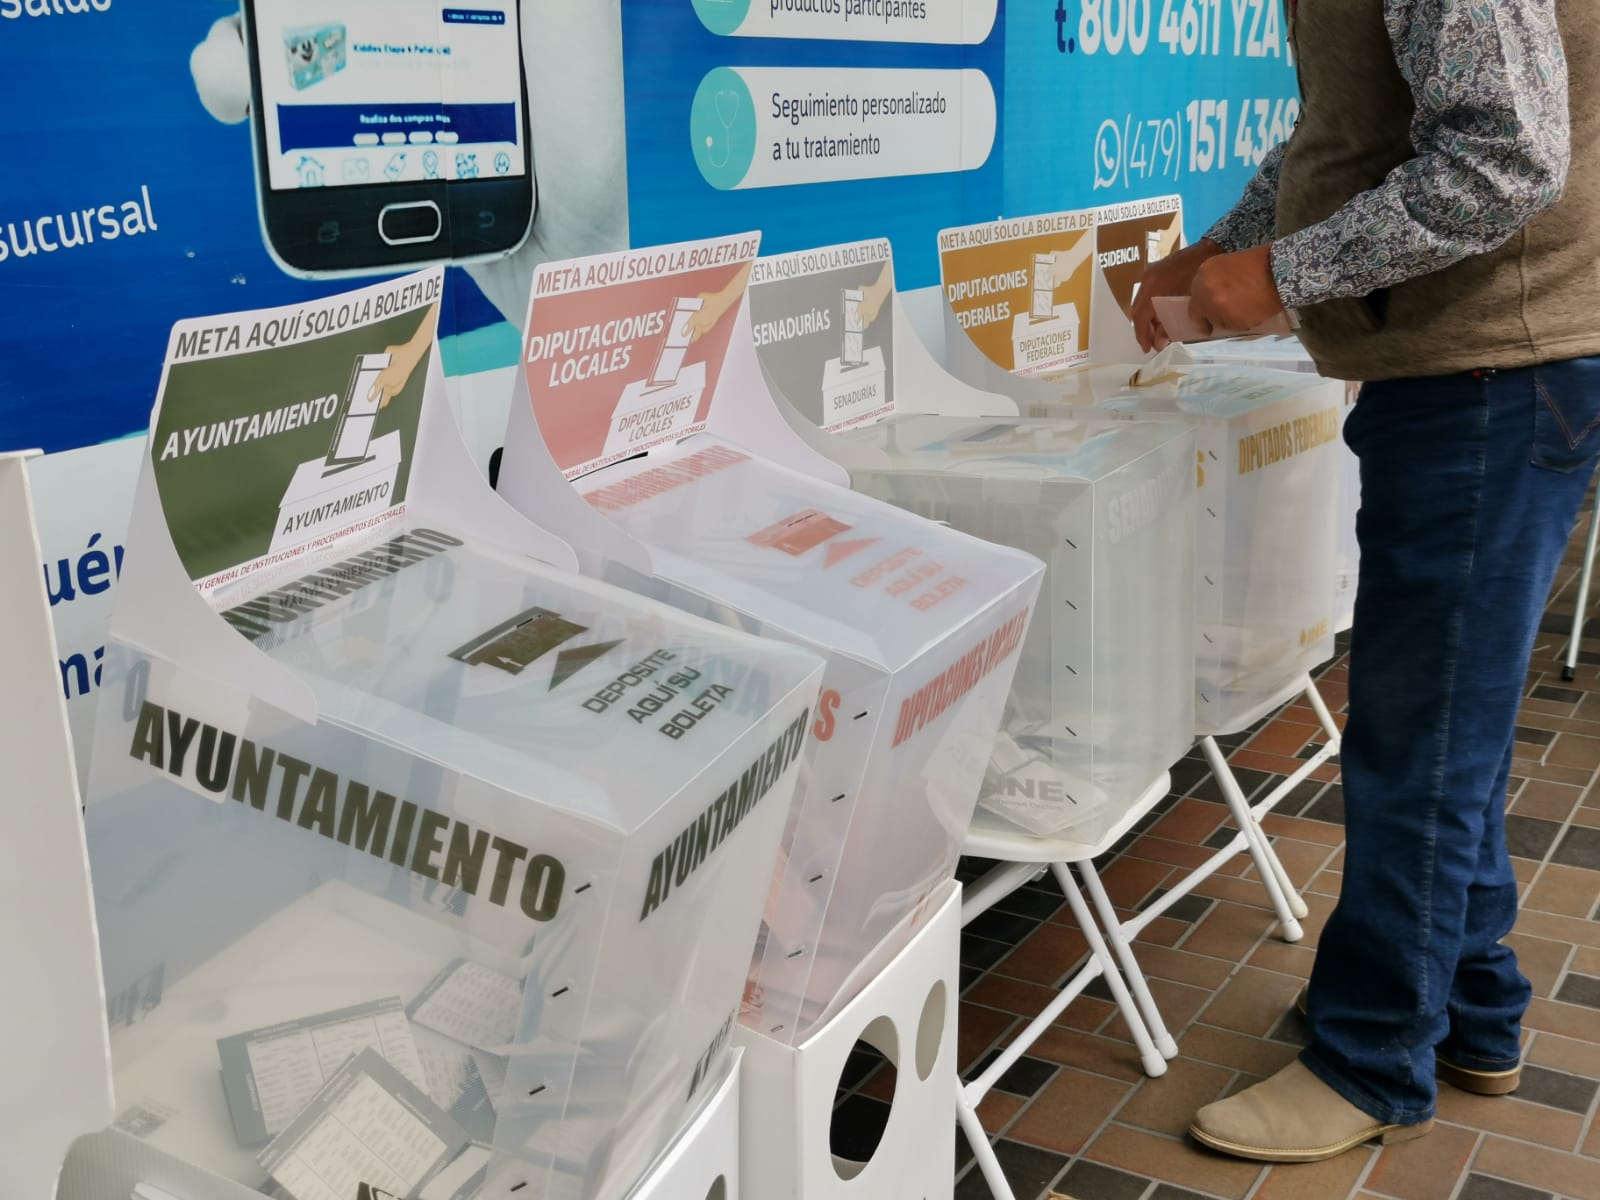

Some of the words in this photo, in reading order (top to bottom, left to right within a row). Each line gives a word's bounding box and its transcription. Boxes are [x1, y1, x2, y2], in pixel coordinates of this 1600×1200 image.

[845, 0, 926, 24] participantes
[1158, 0, 1221, 56] 4611
[772, 92, 858, 125] Seguimiento
[862, 91, 946, 122] personalizado
[772, 142, 782, 160] a
[786, 136, 800, 159] tu
[804, 132, 880, 158] tratamiento
[1123, 111, 1182, 189] (479)
[1186, 99, 1228, 173] 151
[940, 229, 968, 250] META
[968, 223, 993, 246] AQUÍ
[994, 222, 1020, 241] SOLO
[1022, 220, 1035, 236] LA
[1037, 214, 1076, 234] BOLETA
[1079, 212, 1094, 228] DE
[536, 268, 581, 295] META
[585, 255, 626, 287] AQUÍ
[628, 253, 666, 280] SOLO
[668, 251, 686, 272] LA
[688, 243, 738, 269] BOLETA
[740, 239, 758, 259] DE
[775, 254, 800, 278] AQUÍ
[802, 252, 828, 273] SOLO
[829, 250, 841, 268] LA
[843, 247, 877, 266] BOLETA
[878, 242, 890, 259] DE
[1098, 245, 1140, 268] ESIDENCIA
[948, 268, 1028, 302] DIPUTACIONES
[174, 324, 241, 359] META
[246, 309, 303, 348] AQUÍ
[303, 304, 350, 338] SOLO
[352, 298, 370, 326] LA
[374, 282, 423, 320] BOLETA
[425, 275, 441, 302] DE
[527, 309, 667, 363] DIPUTACIONES
[752, 307, 831, 347] SENADURÍAS
[1019, 329, 1072, 353] DIPUTACIONES
[548, 345, 633, 388] LOCALES
[1026, 343, 1065, 363] FEDERALES
[618, 394, 693, 432] DIPUTACIONES
[833, 383, 877, 410] SENADURÍAS
[160, 393, 339, 461] AYUNTAMIENTO
[628, 416, 675, 443] LOCALES
[1238, 421, 1293, 475] DIPUTADOS
[282, 481, 390, 535] AYUNTAMIENTO
[204, 568, 239, 589] GENERAL
[240, 564, 252, 576] DE
[251, 544, 305, 571] INSTITUCIONES
[311, 521, 368, 550] PROCEDIMIENTOS
[367, 504, 407, 530] ELECTORALES
[580, 648, 677, 714] DEPOSITE
[626, 680, 679, 724] AQUÍ
[667, 665, 702, 689] SU
[658, 683, 734, 740] BOLETA
[129, 699, 567, 923] AYUNTAMIENTO
[639, 706, 810, 923] AYUNTAMIENTO
